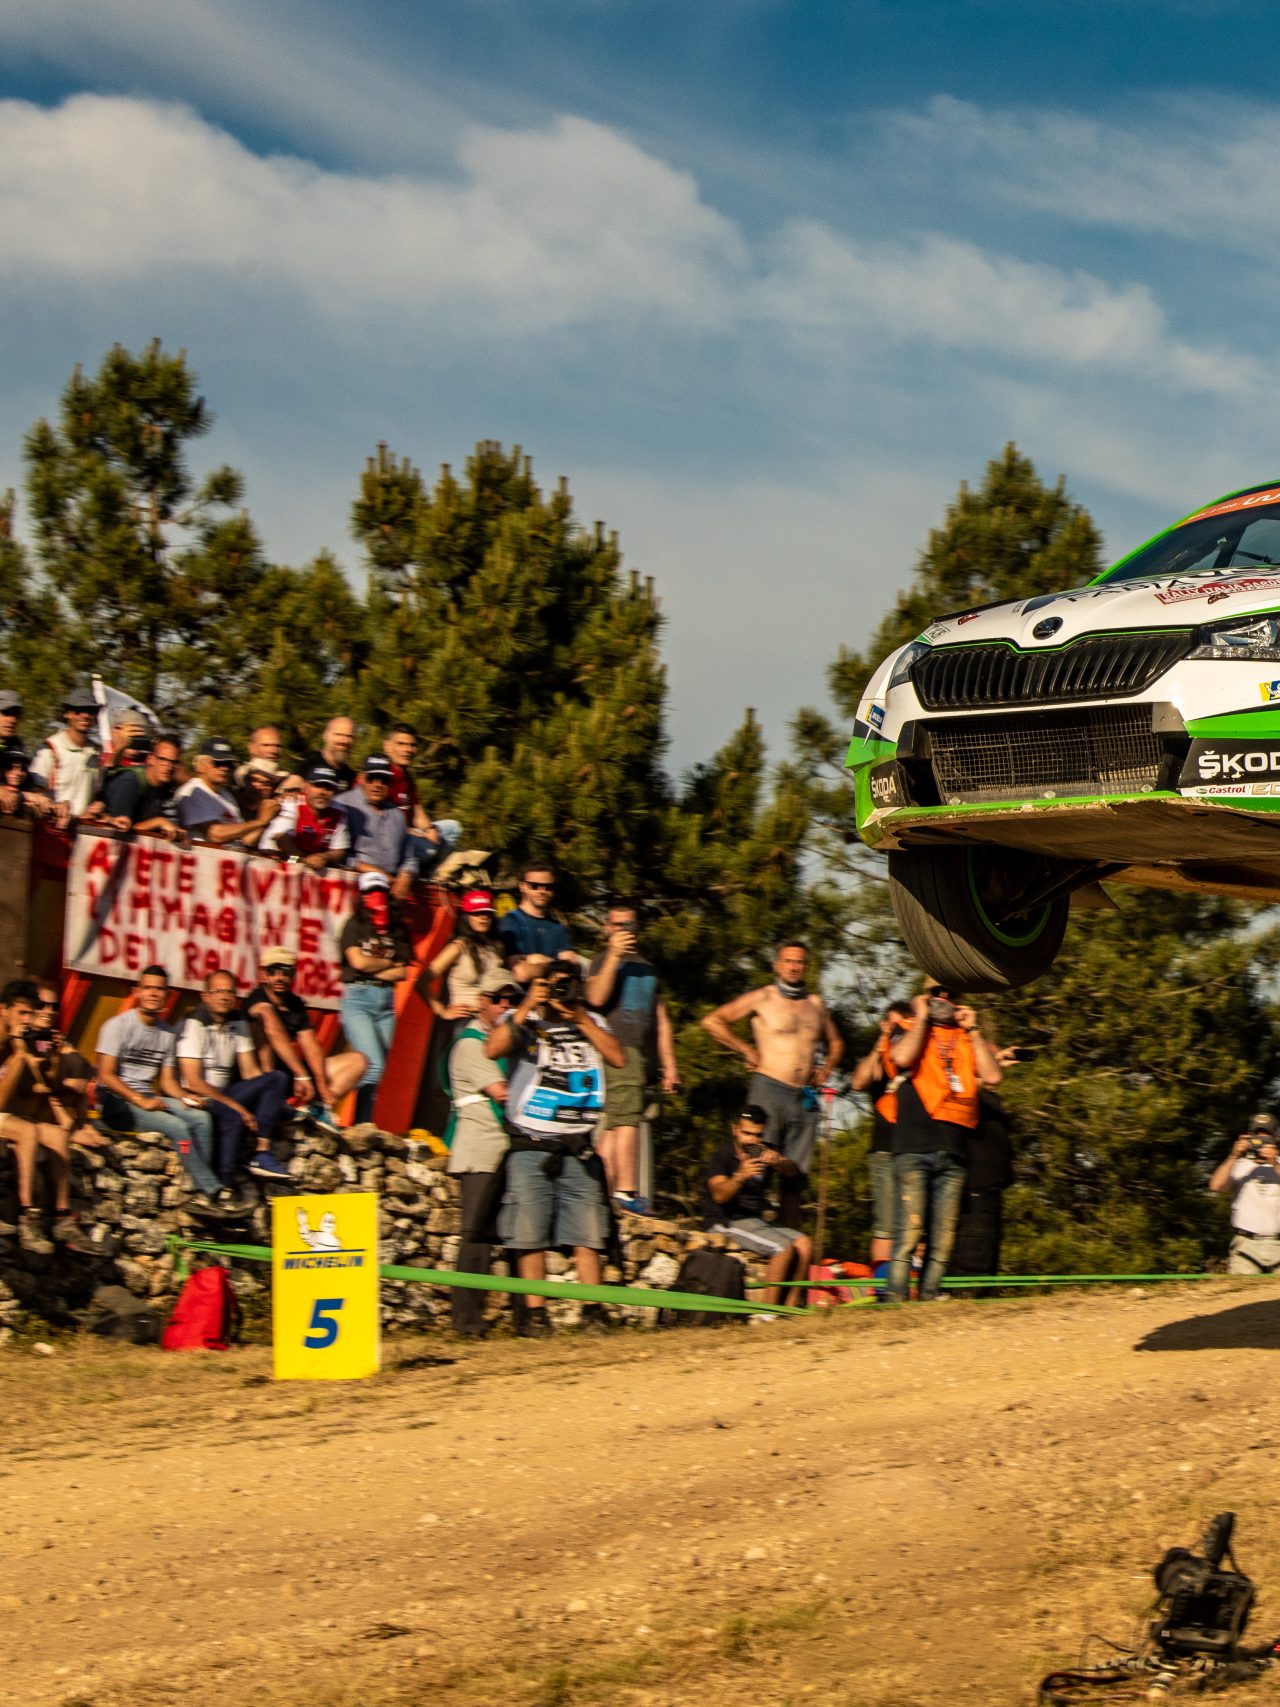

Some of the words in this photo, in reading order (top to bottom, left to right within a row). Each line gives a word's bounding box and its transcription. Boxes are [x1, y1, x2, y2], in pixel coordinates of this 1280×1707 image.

[1164, 587, 1202, 601] RALLY
[1202, 582, 1243, 595] ITALIA
[1208, 785, 1247, 795] Castrol
[283, 1256, 364, 1270] MICHELIN
[304, 1298, 344, 1349] 5
